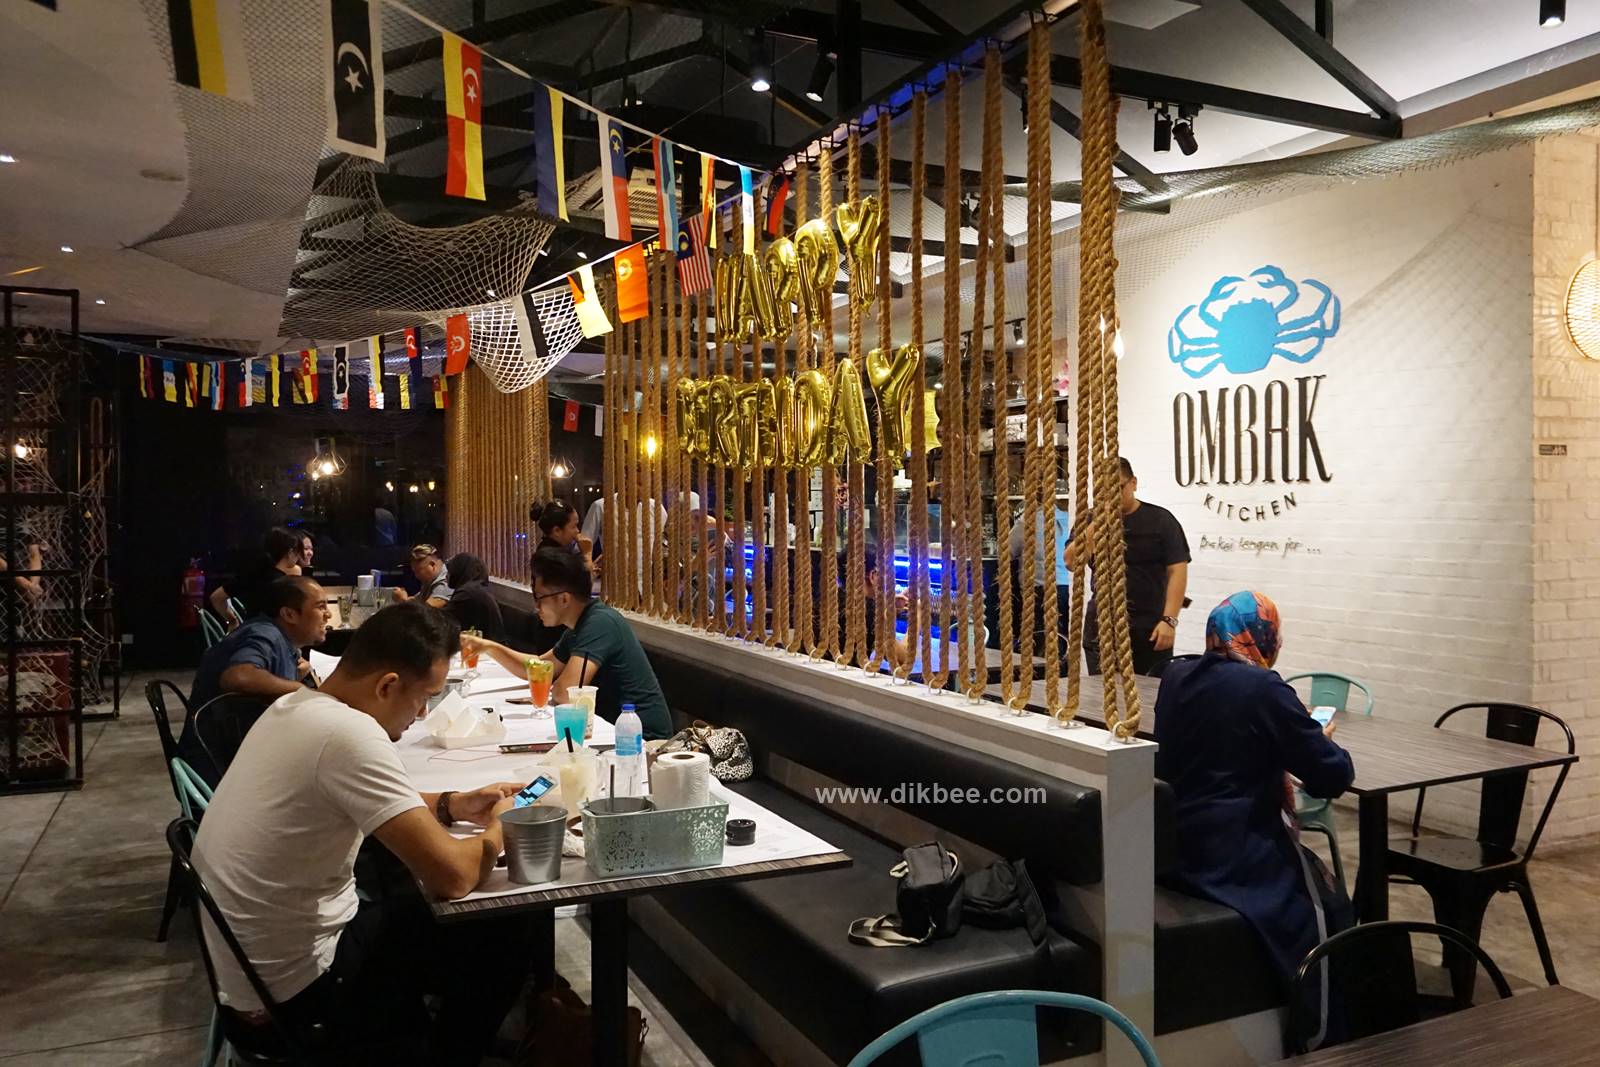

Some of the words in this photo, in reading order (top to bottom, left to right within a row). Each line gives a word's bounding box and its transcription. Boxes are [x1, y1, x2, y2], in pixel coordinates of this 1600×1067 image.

[716, 195, 882, 344] HAPPY
[676, 342, 920, 469] BIRTHDAY
[1172, 374, 1333, 488] OMBAK
[1203, 491, 1298, 522] KITCHEN
